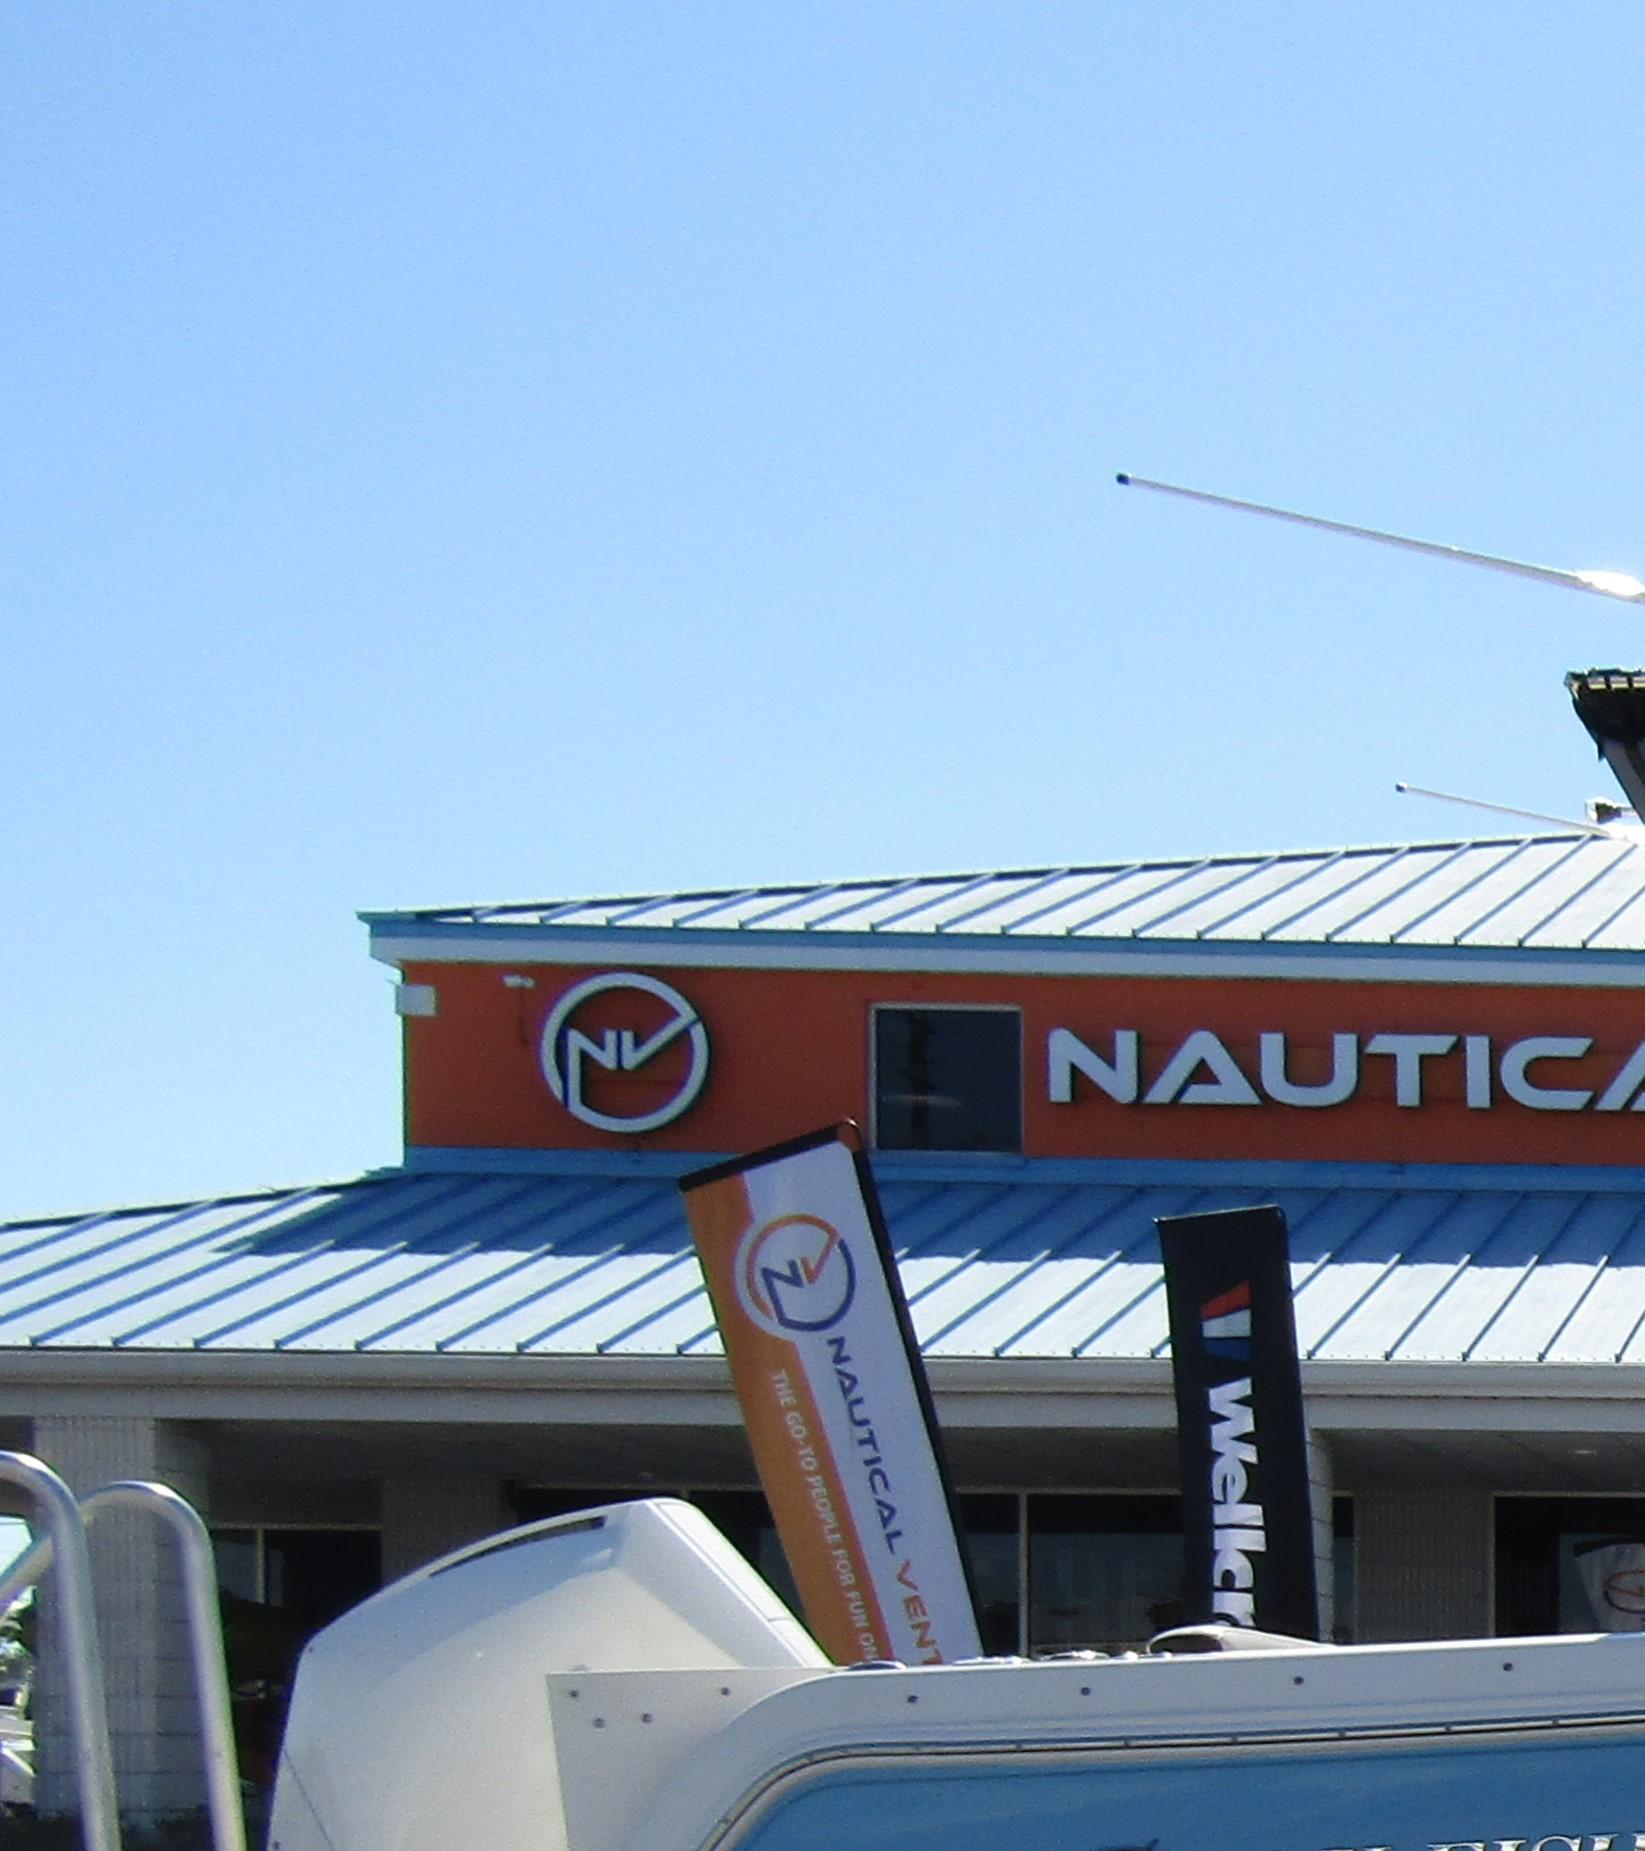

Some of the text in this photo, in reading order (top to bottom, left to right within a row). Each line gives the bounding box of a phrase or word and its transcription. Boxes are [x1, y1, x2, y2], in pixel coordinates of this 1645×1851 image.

[771, 1367, 797, 1407] THE
[804, 1474, 843, 1545] PEOPLE
[832, 1548, 856, 1588] FOR
[846, 1588, 871, 1629] FUN
[826, 1335, 903, 1555] NAUTICAL
